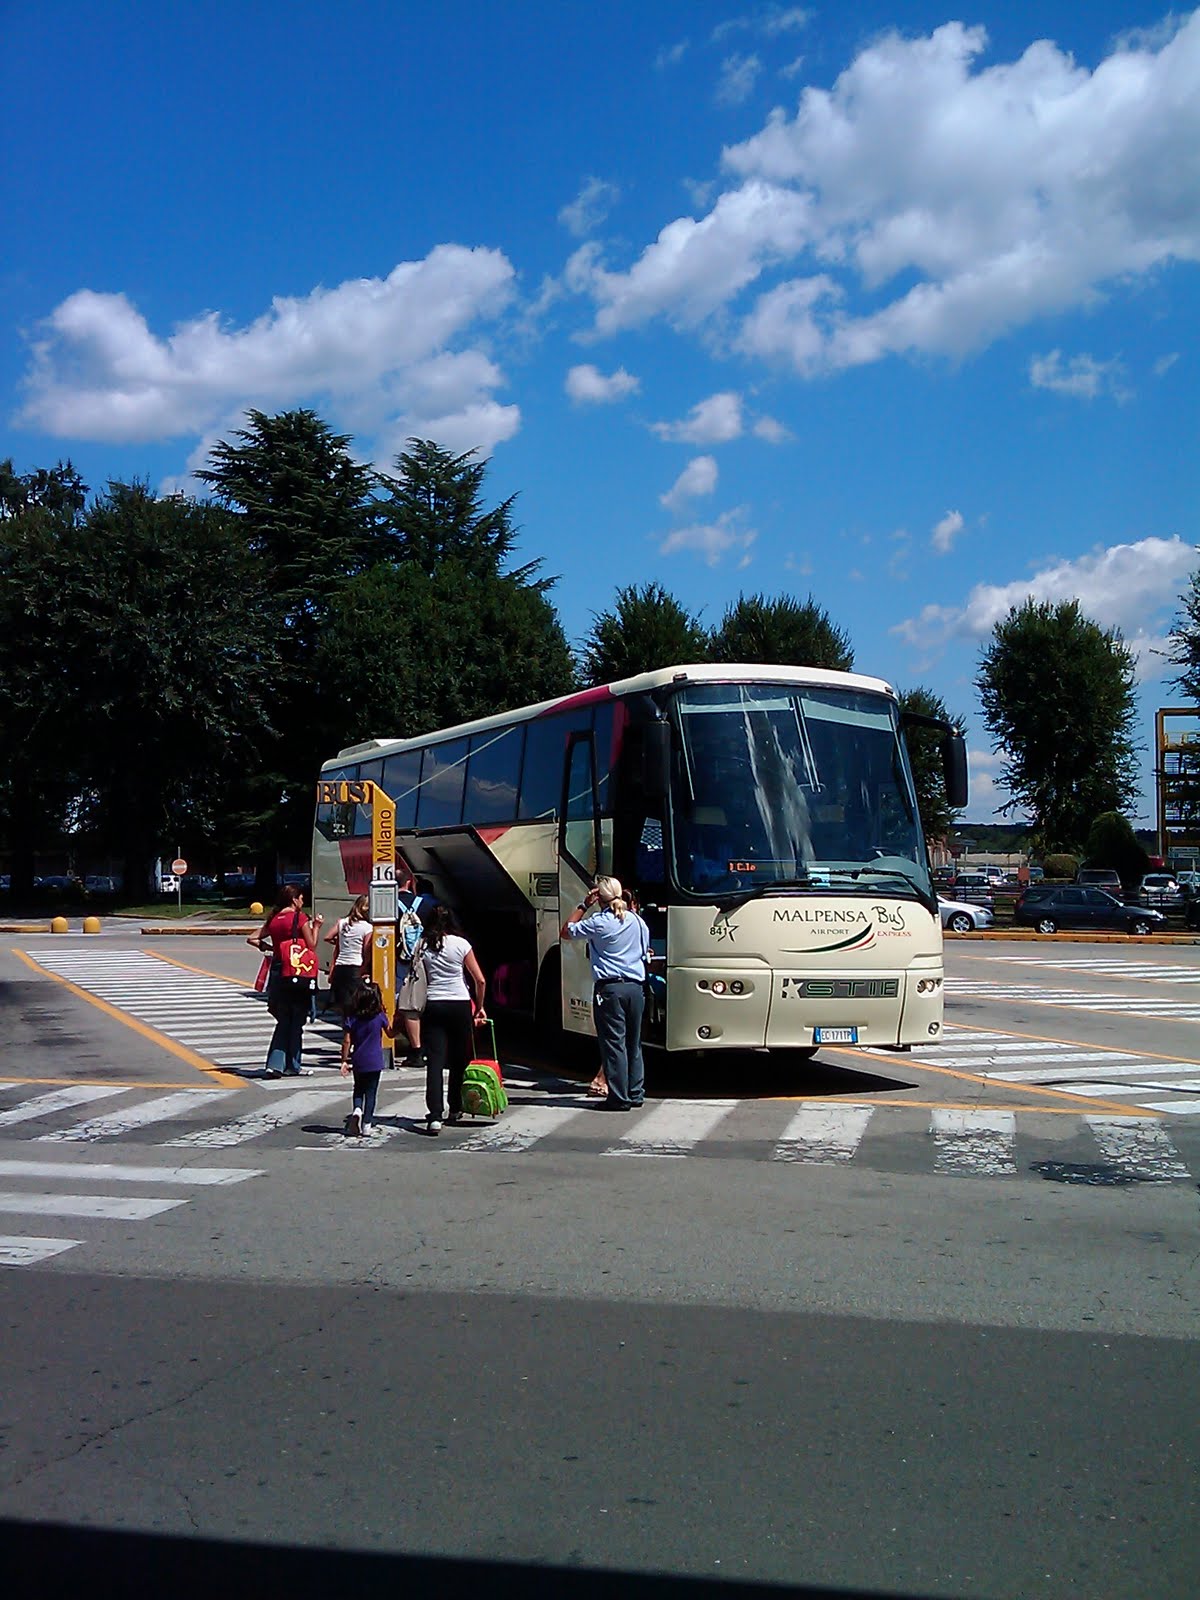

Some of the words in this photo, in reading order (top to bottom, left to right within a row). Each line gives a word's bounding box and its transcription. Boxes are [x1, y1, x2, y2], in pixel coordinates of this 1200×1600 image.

[317, 781, 366, 805] BUS
[377, 809, 392, 862] Milano
[374, 865, 394, 881] 16
[772, 909, 868, 923] MALPENSA
[709, 926, 728, 936] 841
[810, 928, 850, 936] AIRPORT
[877, 930, 913, 938] EXPRESS
